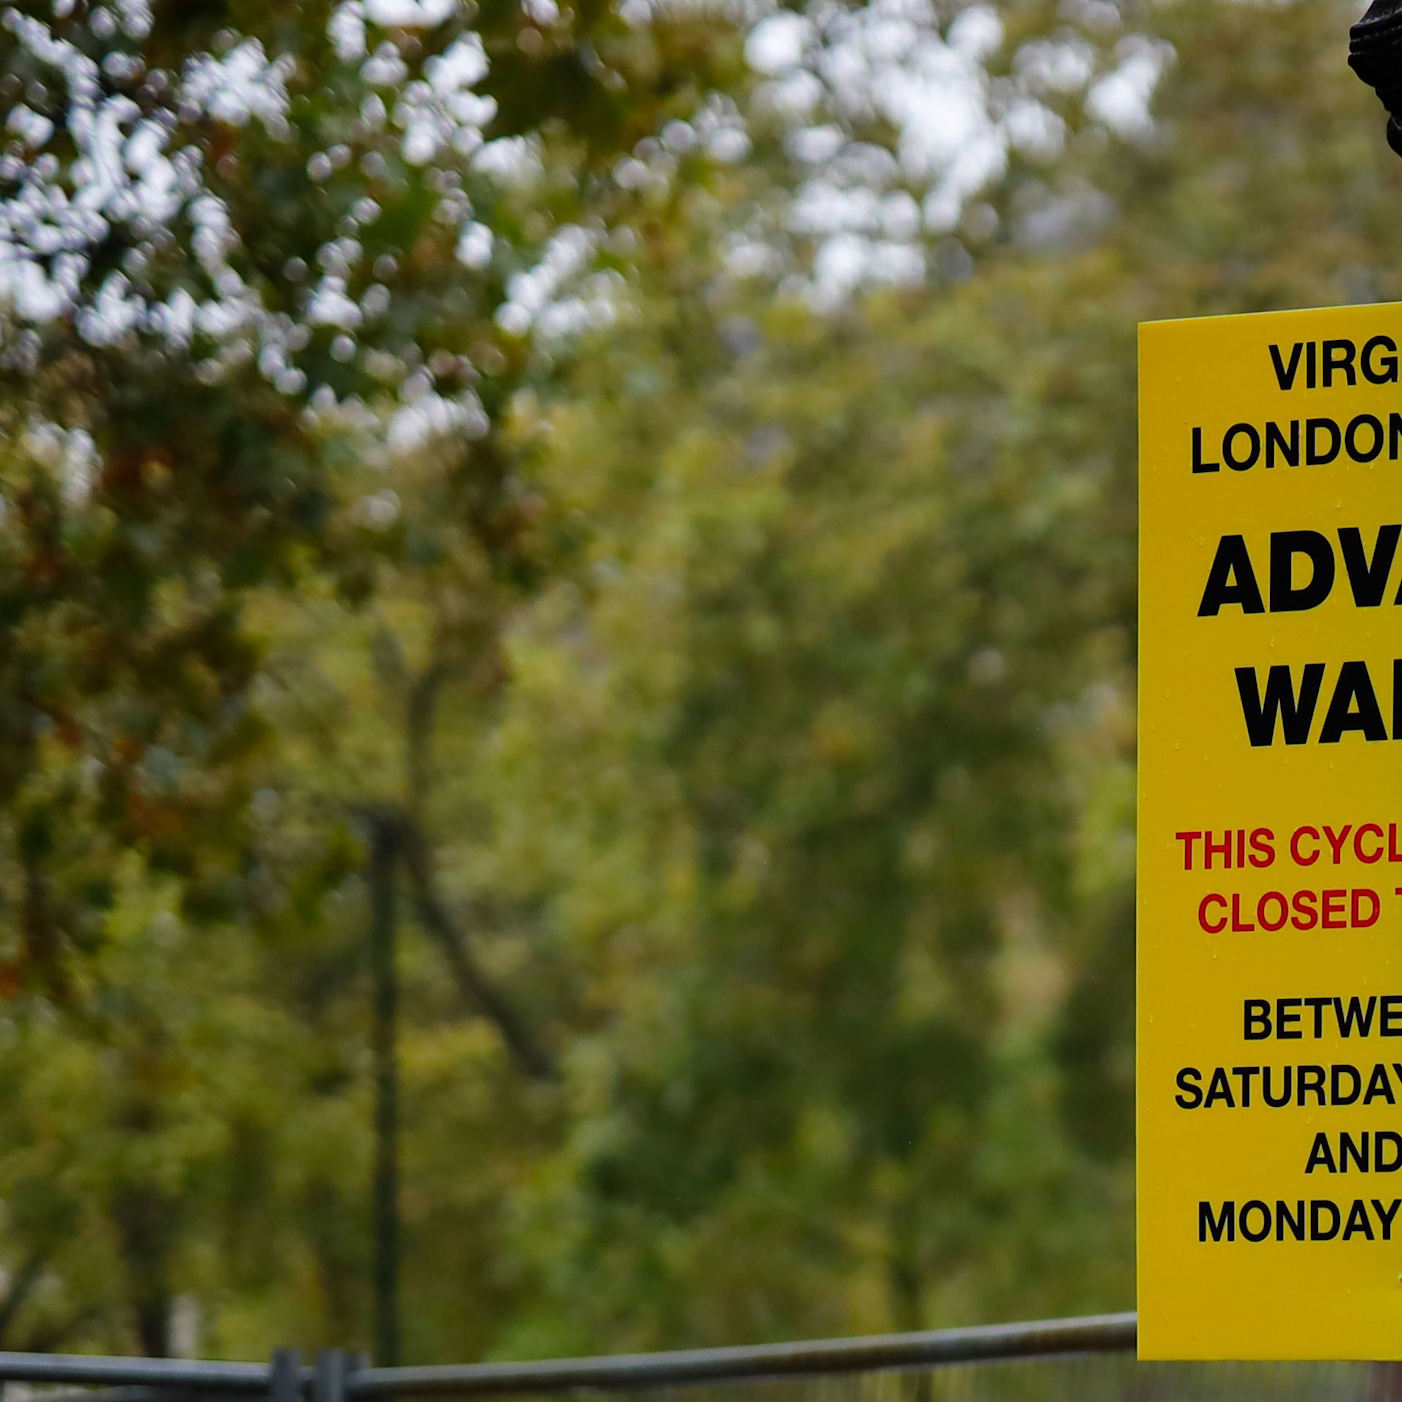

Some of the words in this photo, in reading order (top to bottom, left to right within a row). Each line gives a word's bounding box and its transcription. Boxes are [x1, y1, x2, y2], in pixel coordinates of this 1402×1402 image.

[1176, 827, 1275, 870] THIS
[1198, 889, 1380, 933] CLOSED
[1199, 1199, 1402, 1242] MONDAY
